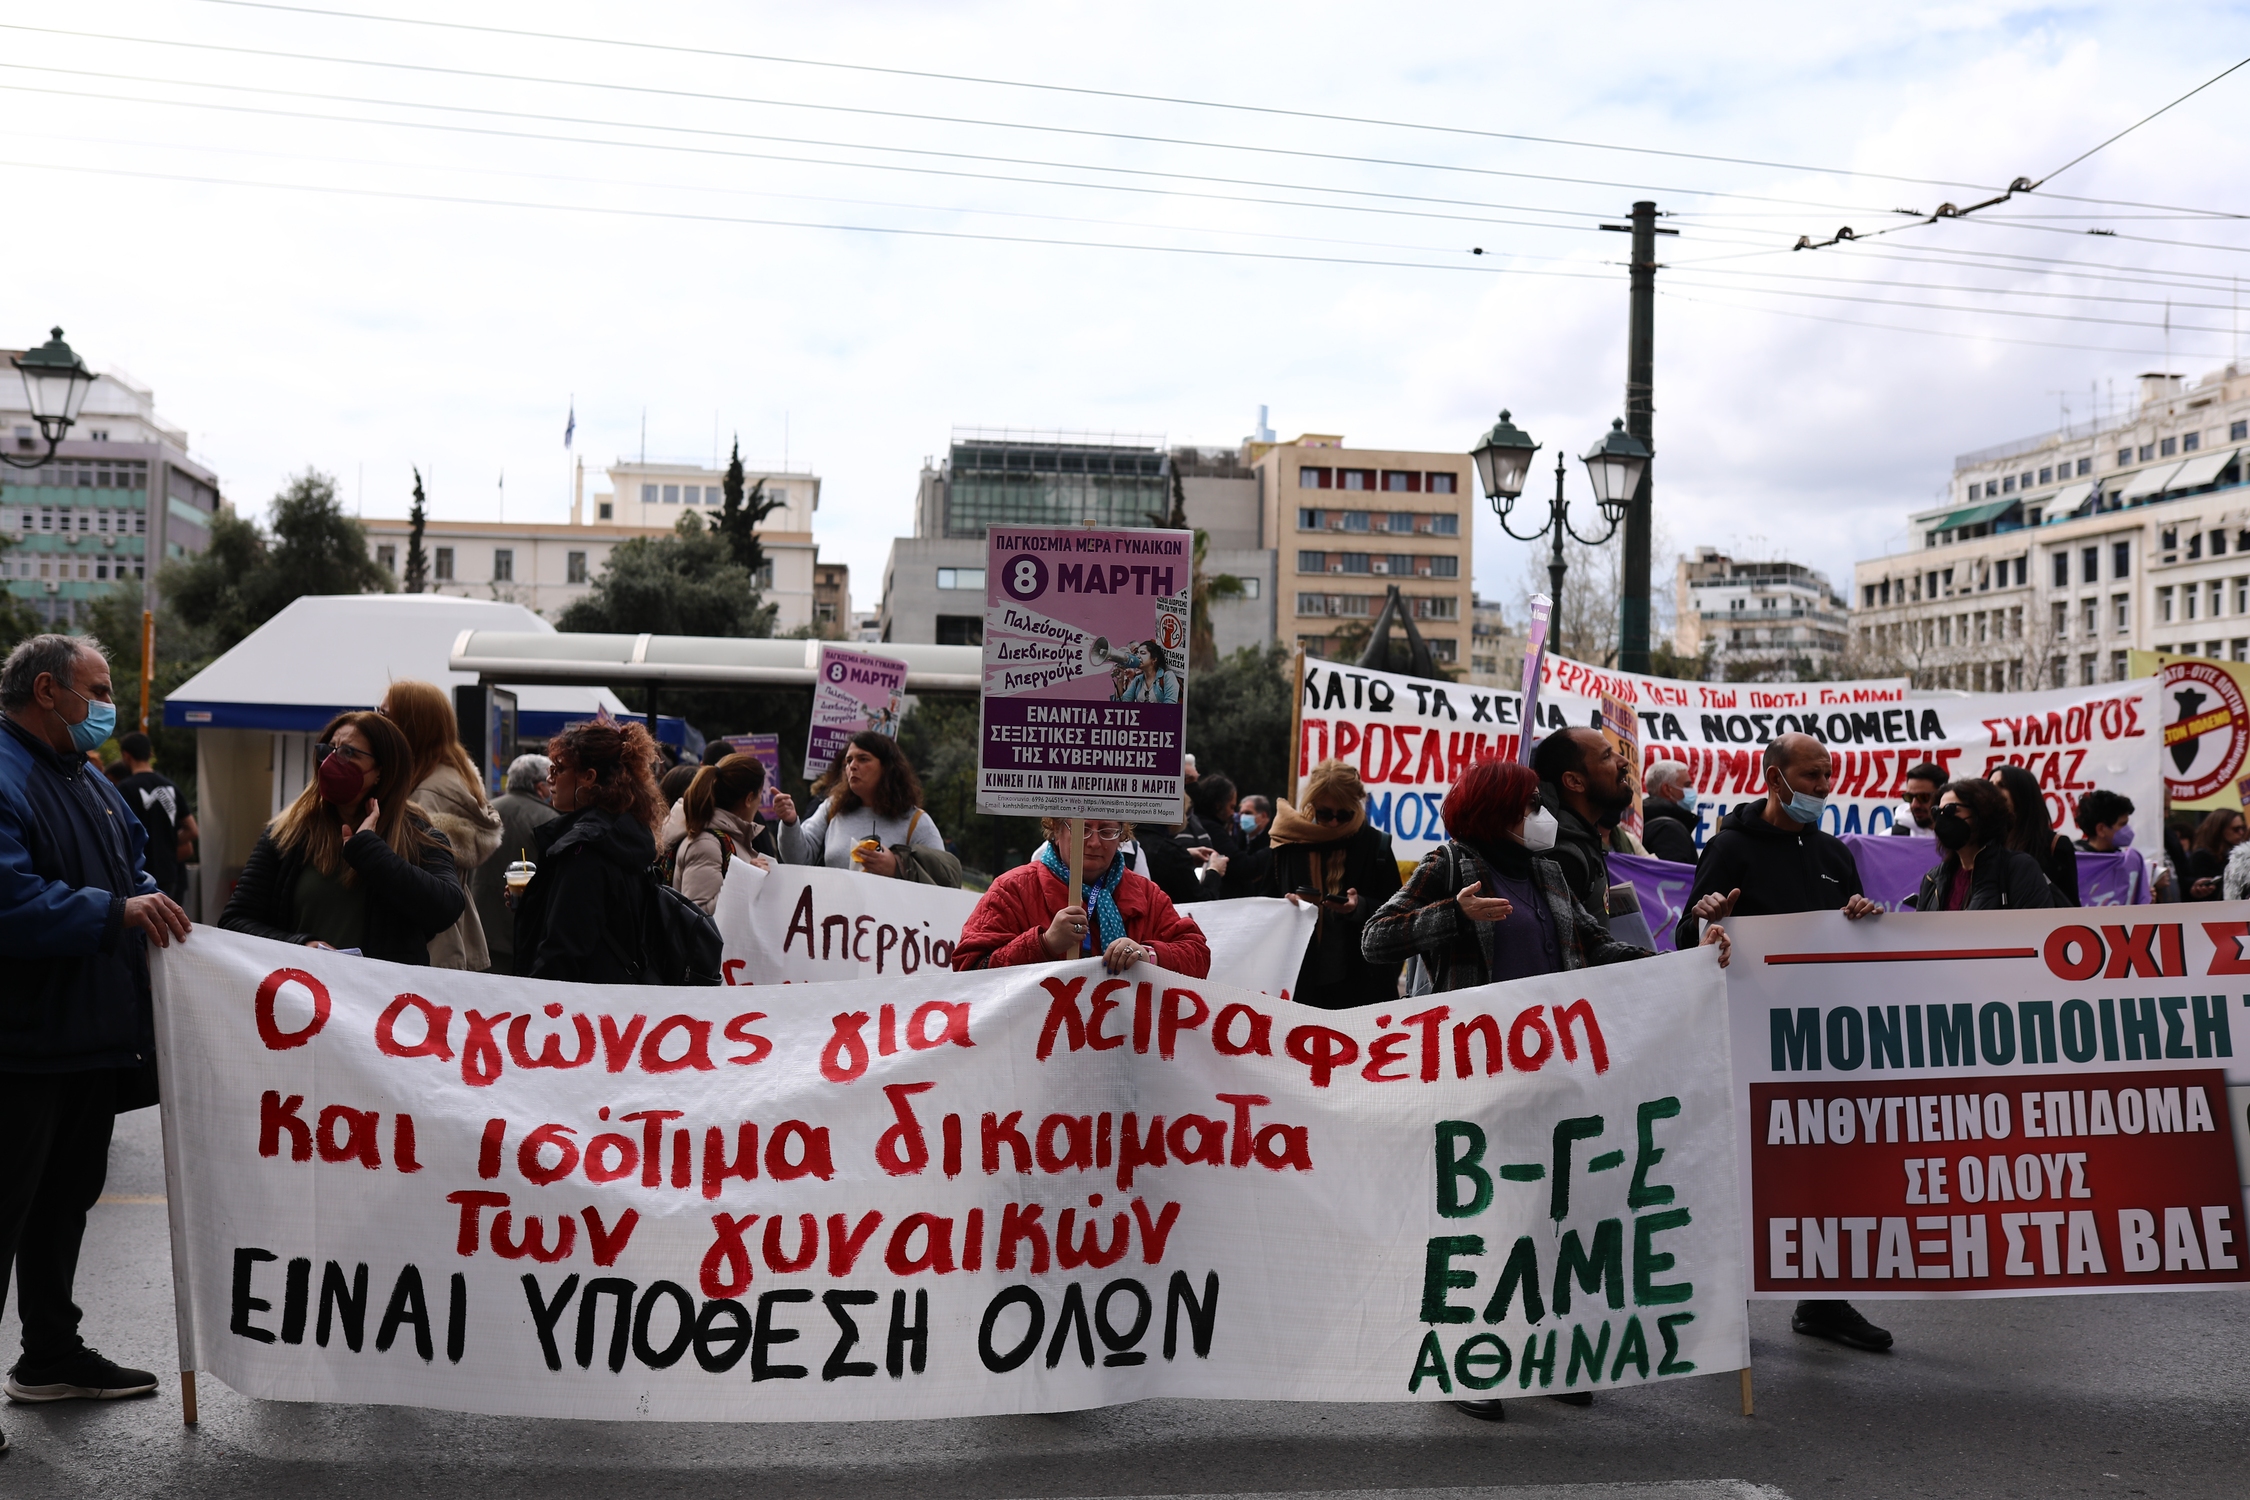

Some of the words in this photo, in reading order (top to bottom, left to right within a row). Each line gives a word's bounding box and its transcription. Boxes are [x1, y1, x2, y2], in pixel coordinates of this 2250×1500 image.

[996, 535, 1072, 552] ΠΑΓΚΟΣΜΙΑ
[1075, 537, 1111, 553] ΜΕΡΑ
[1013, 560, 1038, 594] 8
[1057, 562, 1174, 597] ΜΑΡΤΗ
[997, 642, 1083, 665] Διεκδικούμε
[1003, 609, 1083, 646] Παλεύουμε
[831, 663, 843, 681] 8
[850, 667, 899, 689] ΜΑΡΤΗ
[1004, 661, 1083, 690] Απεργούμε
[1303, 667, 1395, 712] ΚΑΤΩ
[1407, 683, 1458, 722] ΤΑ
[990, 724, 1086, 745] ΣΕΞΙΣΤΙΚΕΣ
[1090, 728, 1175, 748] ΕΠΙΘΕΣΕΙΣ
[1103, 708, 1141, 727] ΣΤΙΣ
[1981, 695, 2146, 748] ΣΥΛΛΟΓΟΣ
[985, 772, 1024, 788] ΚΙΝΗΣΗ
[1027, 774, 1044, 789] ΓΙΑ
[1047, 775, 1067, 790] ΤΗΝ
[1070, 777, 1128, 793] ΑΠΕΡΓΙΑΚΗ
[1131, 779, 1138, 793] 8
[1141, 780, 1176, 795] ΜΑΡΤΗ
[1011, 746, 1044, 764] ΤΗΣ
[1048, 748, 1158, 768] ΚΥΒΕΡΝΗΣΗΣ
[2043, 922, 2188, 982] ΟΧΙ
[254, 968, 332, 1051] Ο
[375, 991, 773, 1086] αγώνας
[819, 1000, 977, 1083] για
[1035, 975, 1610, 1088] χειραφέτηση
[1769, 994, 2234, 1072] ΜΟΝΙΜΟΠΟΙΗΣΗ
[1766, 1092, 2011, 1146] ΑΝΘΥΓΙΕΙΝΟ
[2021, 1086, 2216, 1138] ΕΠΙΔΟΜΑ
[258, 1089, 424, 1174] και
[477, 1106, 836, 1200] ισότιμα
[1904, 1157, 1950, 1205] ΣΕ
[1957, 1152, 2092, 1203] ΟΛΟΥΣ
[446, 1190, 640, 1267] των
[700, 1194, 1181, 1300] γυναικών
[1419, 1207, 1694, 1327] ΕΛΜΕ
[1768, 1214, 1990, 1279] ΕΝΤΑΞΗ
[2001, 1209, 2108, 1276] ΣΤΑ
[2117, 1205, 2239, 1273] ΒΑΕ
[230, 1247, 468, 1364] ΕΙΝΑΙ
[520, 1272, 929, 1382] ΥΠΟΘΕΣΗ
[978, 1269, 1220, 1374] ΟΛΩΝ
[1407, 1311, 1698, 1395] ΑΘΗΝΑΣ
